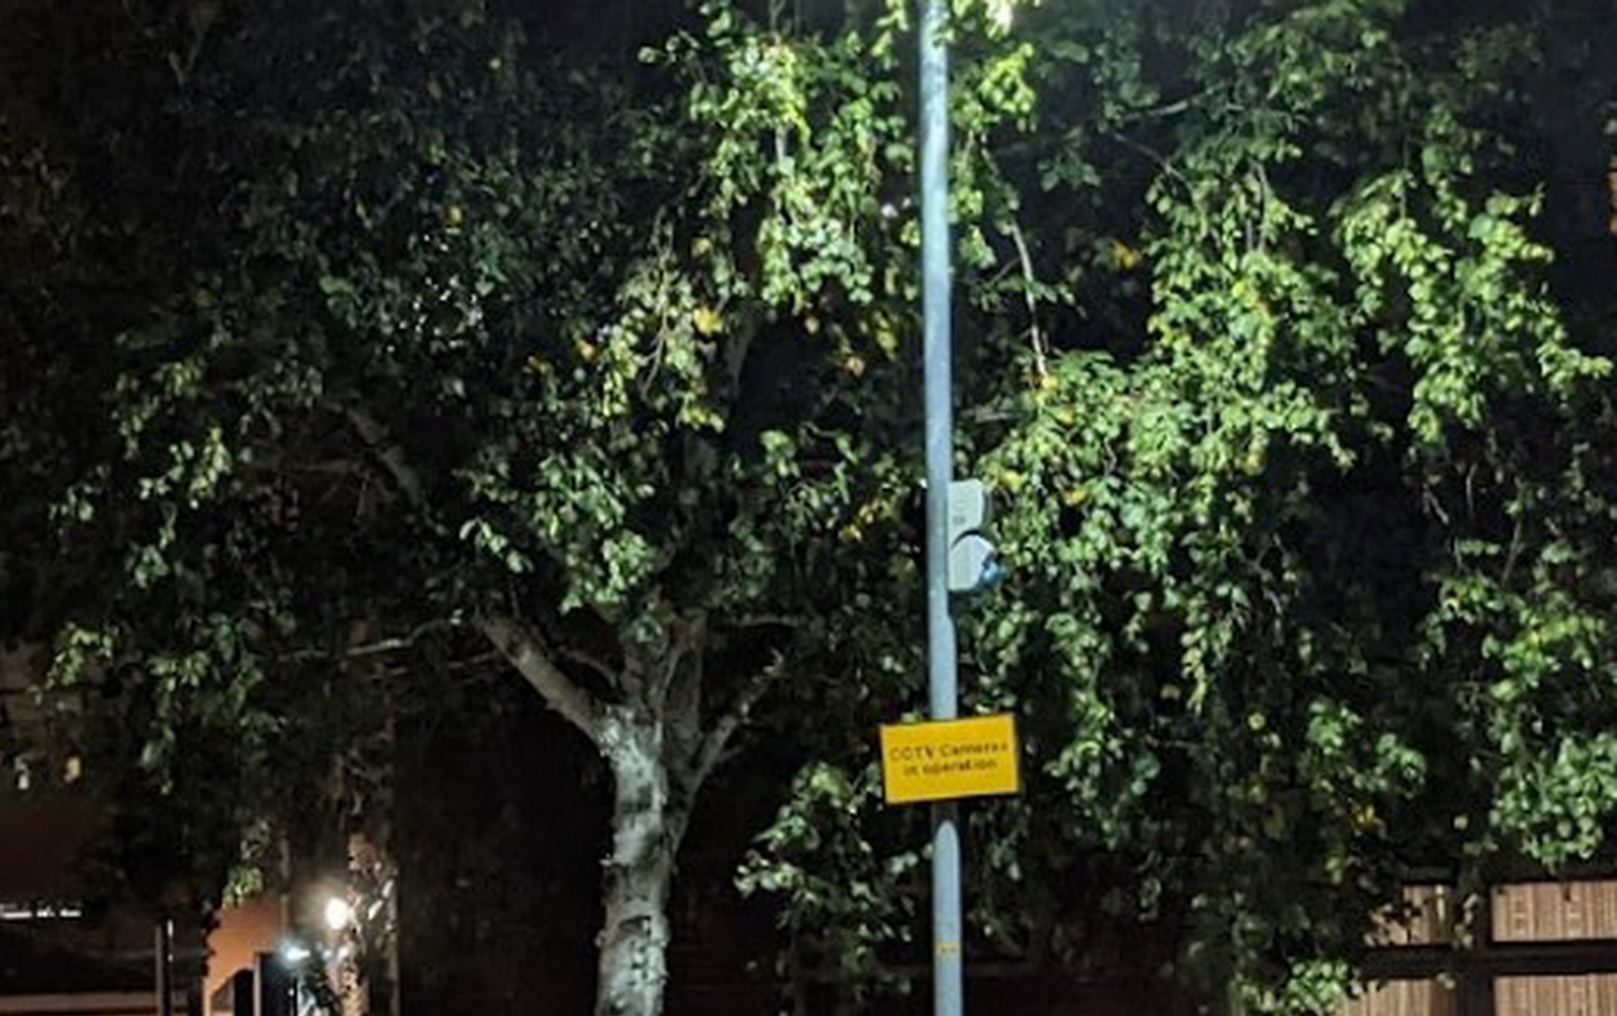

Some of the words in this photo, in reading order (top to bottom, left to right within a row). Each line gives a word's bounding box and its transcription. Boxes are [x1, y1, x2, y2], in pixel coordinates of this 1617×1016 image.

[891, 745, 934, 761] CCTV
[939, 742, 1008, 757] Cameras
[903, 764, 918, 777] in
[923, 759, 998, 777] operation
